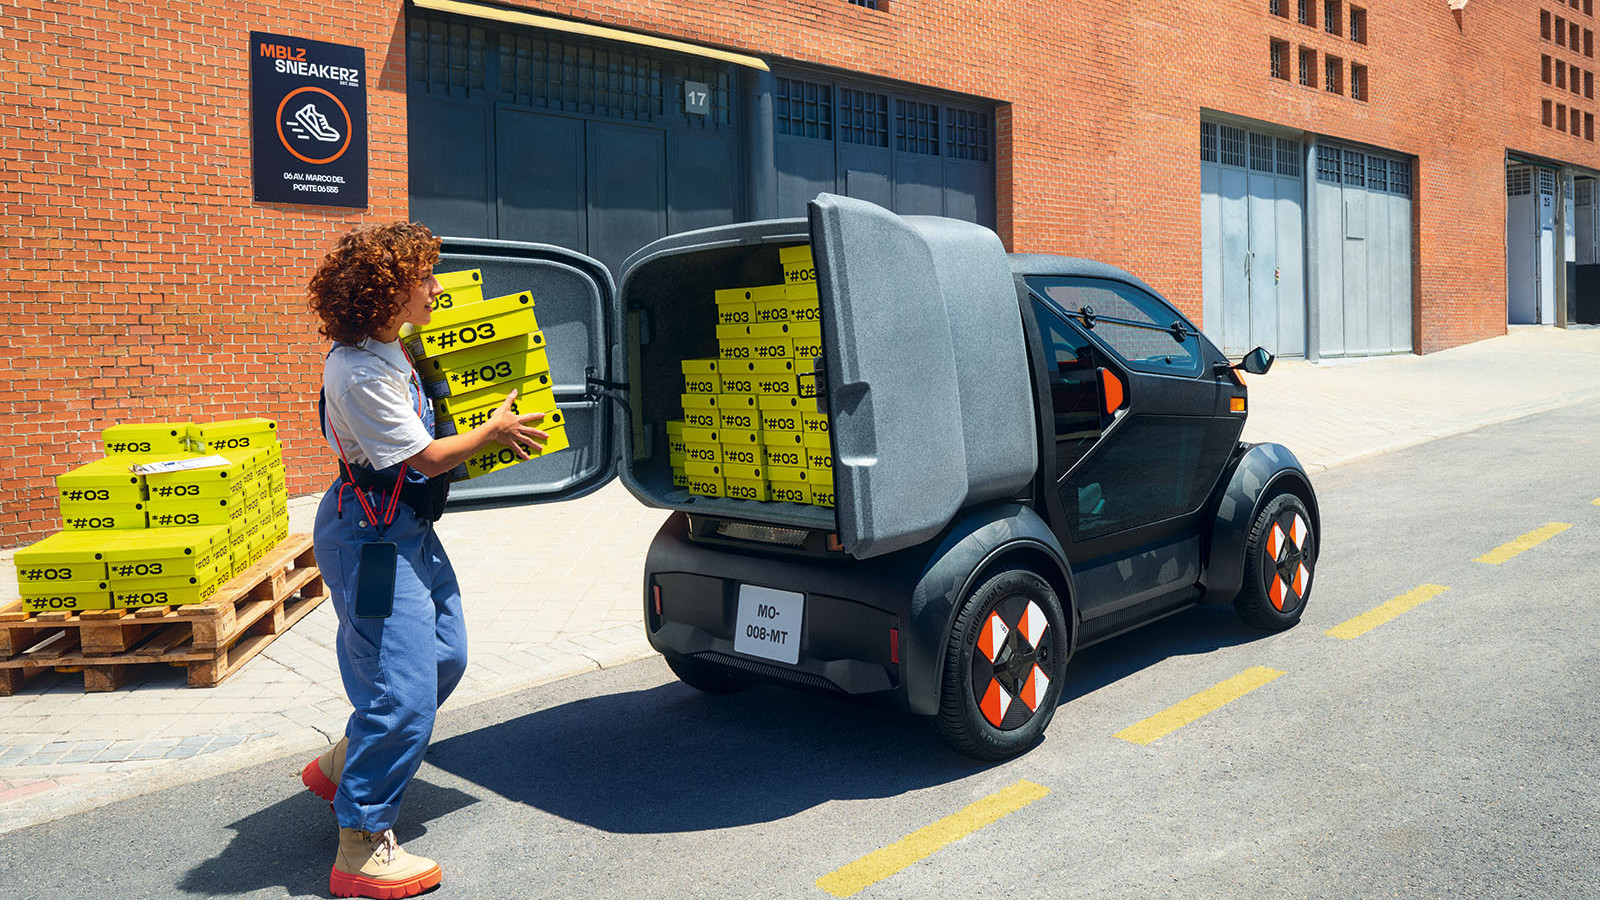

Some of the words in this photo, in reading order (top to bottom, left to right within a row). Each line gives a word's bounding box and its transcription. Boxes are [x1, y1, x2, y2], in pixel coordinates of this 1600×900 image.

[260, 43, 306, 62] MBLZ
[275, 59, 358, 82] SNEAKERZ
[688, 91, 706, 106] 17
[306, 174, 332, 182] MARCO
[332, 176, 346, 184] DEL
[293, 184, 318, 192] PONTE
[804, 420, 828, 432] #0
[809, 456, 832, 468] #0
[757, 604, 780, 618] MO-
[746, 624, 788, 644] 008-MT
